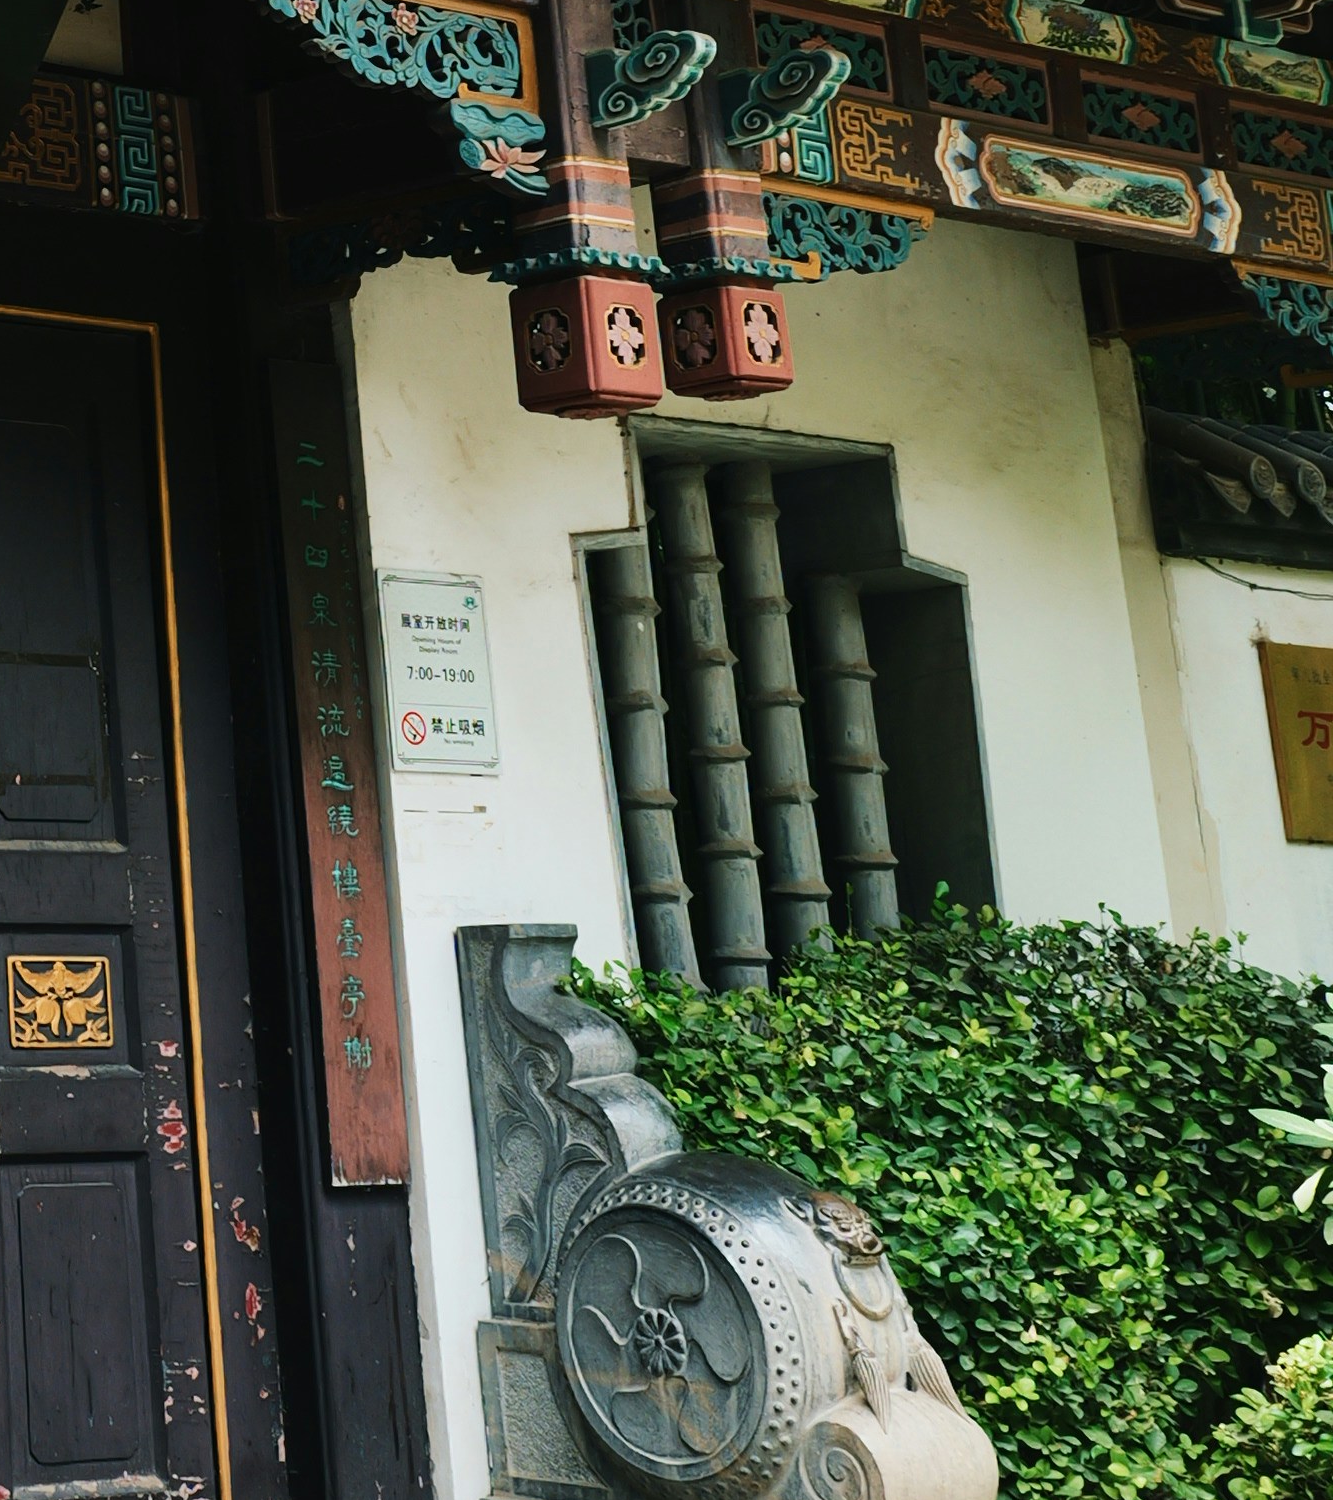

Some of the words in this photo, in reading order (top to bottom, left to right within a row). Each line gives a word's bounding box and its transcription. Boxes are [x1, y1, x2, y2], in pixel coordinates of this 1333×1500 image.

[401, 613, 470, 633] 展室开放时间
[406, 665, 475, 683] 7:00-19:00
[431, 717, 485, 737] 禁止吸烟
